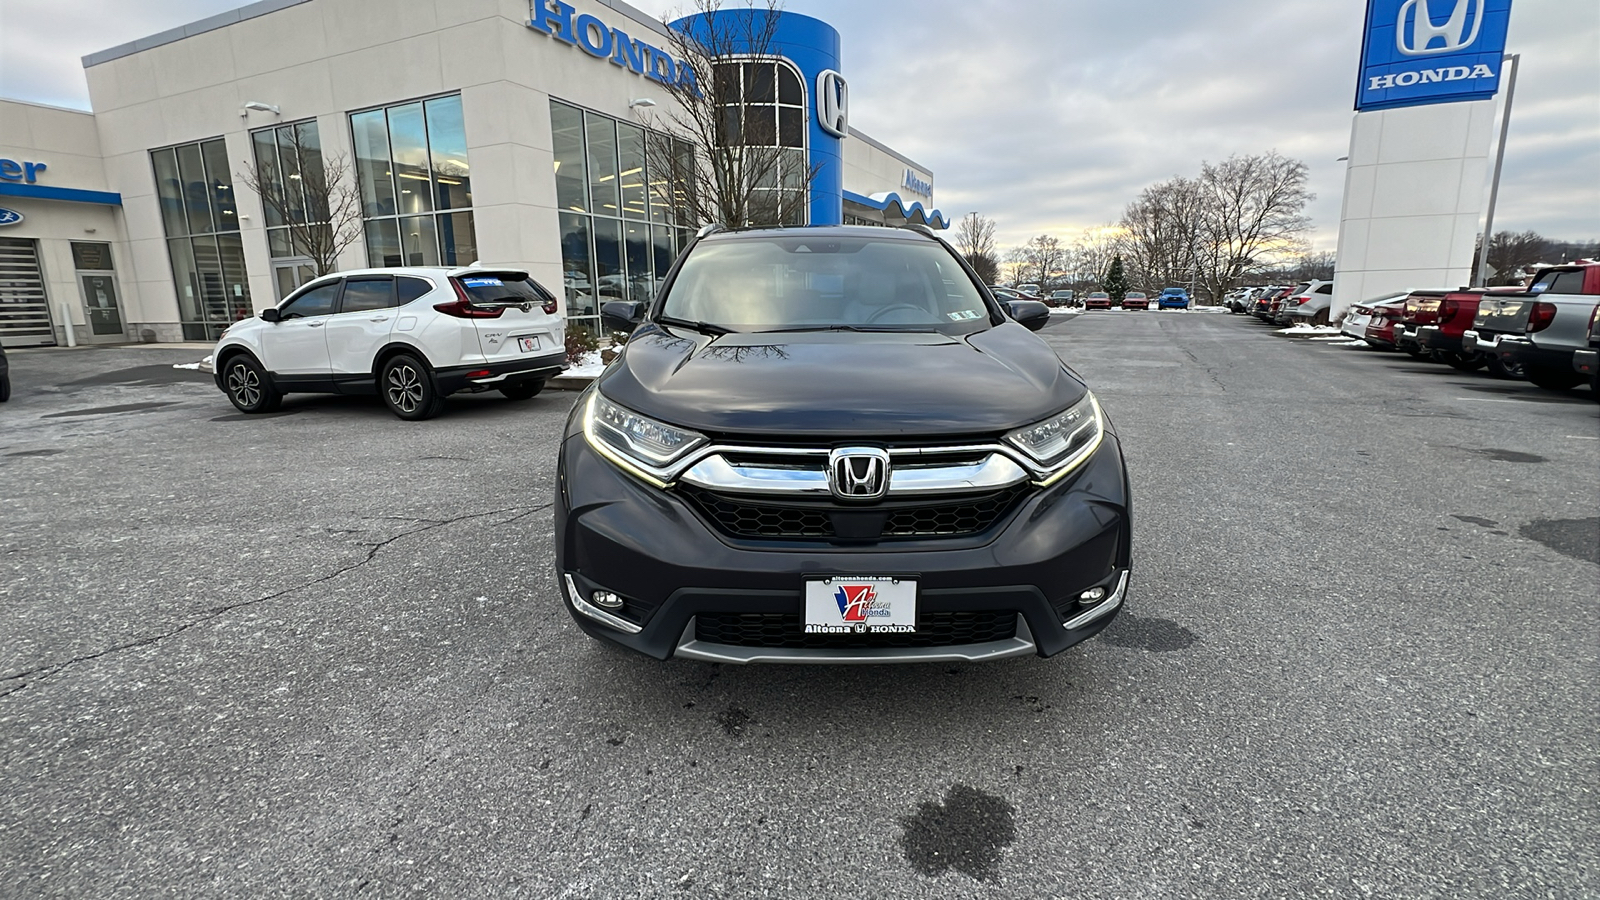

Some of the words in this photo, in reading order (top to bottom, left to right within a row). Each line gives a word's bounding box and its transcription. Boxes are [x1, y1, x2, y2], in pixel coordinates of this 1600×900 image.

[527, 0, 704, 100] HONDA
[1368, 64, 1495, 90] HONDA
[862, 608, 891, 617] Honda
[804, 623, 851, 634] Altoona
[870, 624, 916, 634] HONDA
